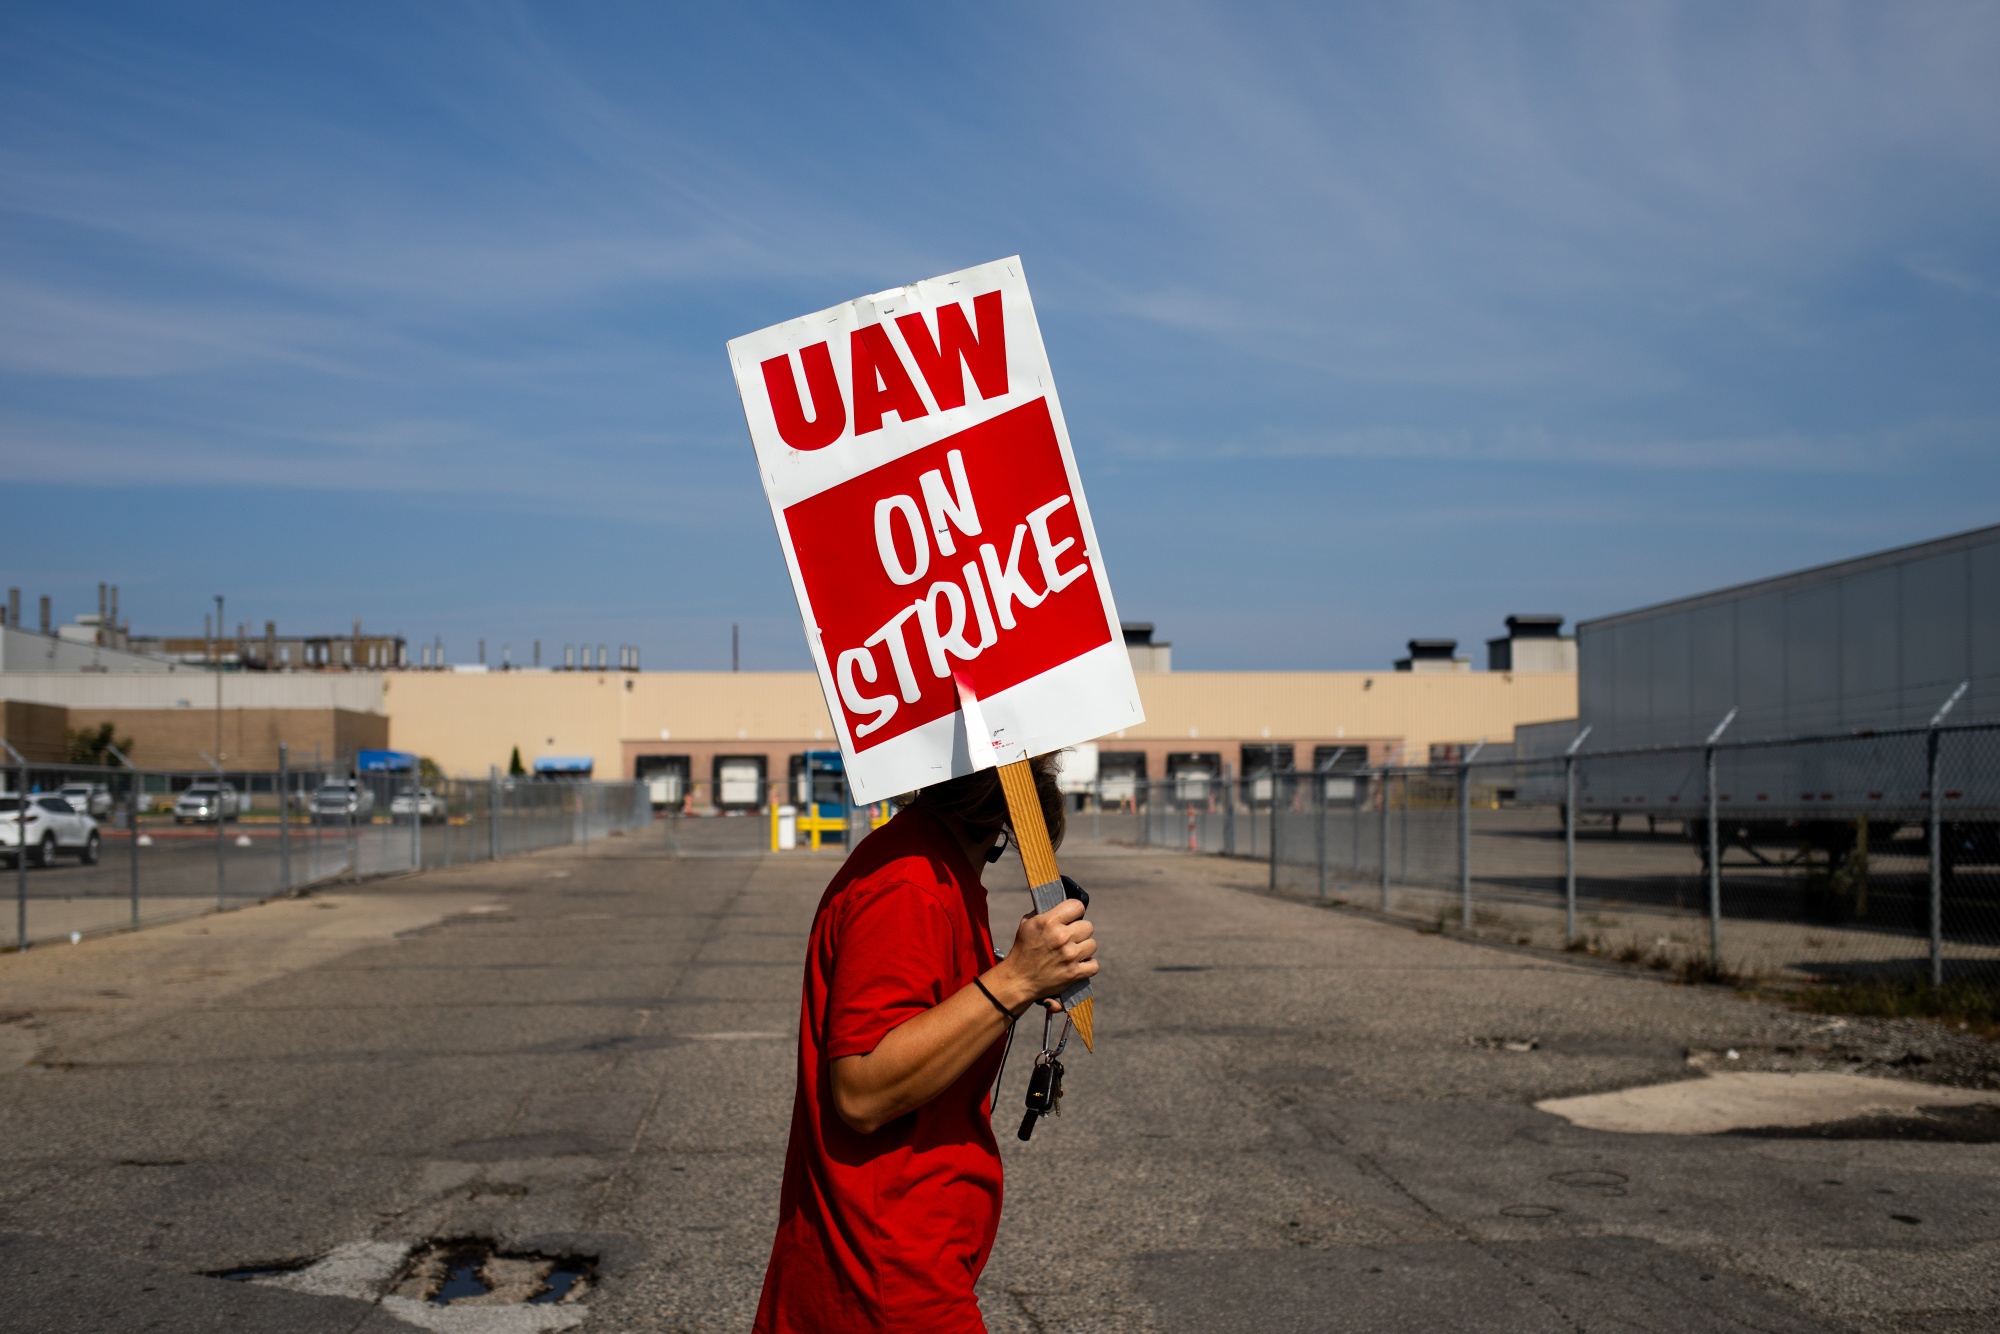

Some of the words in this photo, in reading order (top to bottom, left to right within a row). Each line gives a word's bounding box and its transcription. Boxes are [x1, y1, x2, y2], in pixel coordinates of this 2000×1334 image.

[761, 290, 1010, 451] UAW
[874, 449, 983, 586] ON
[836, 494, 1088, 739] STRIKE
